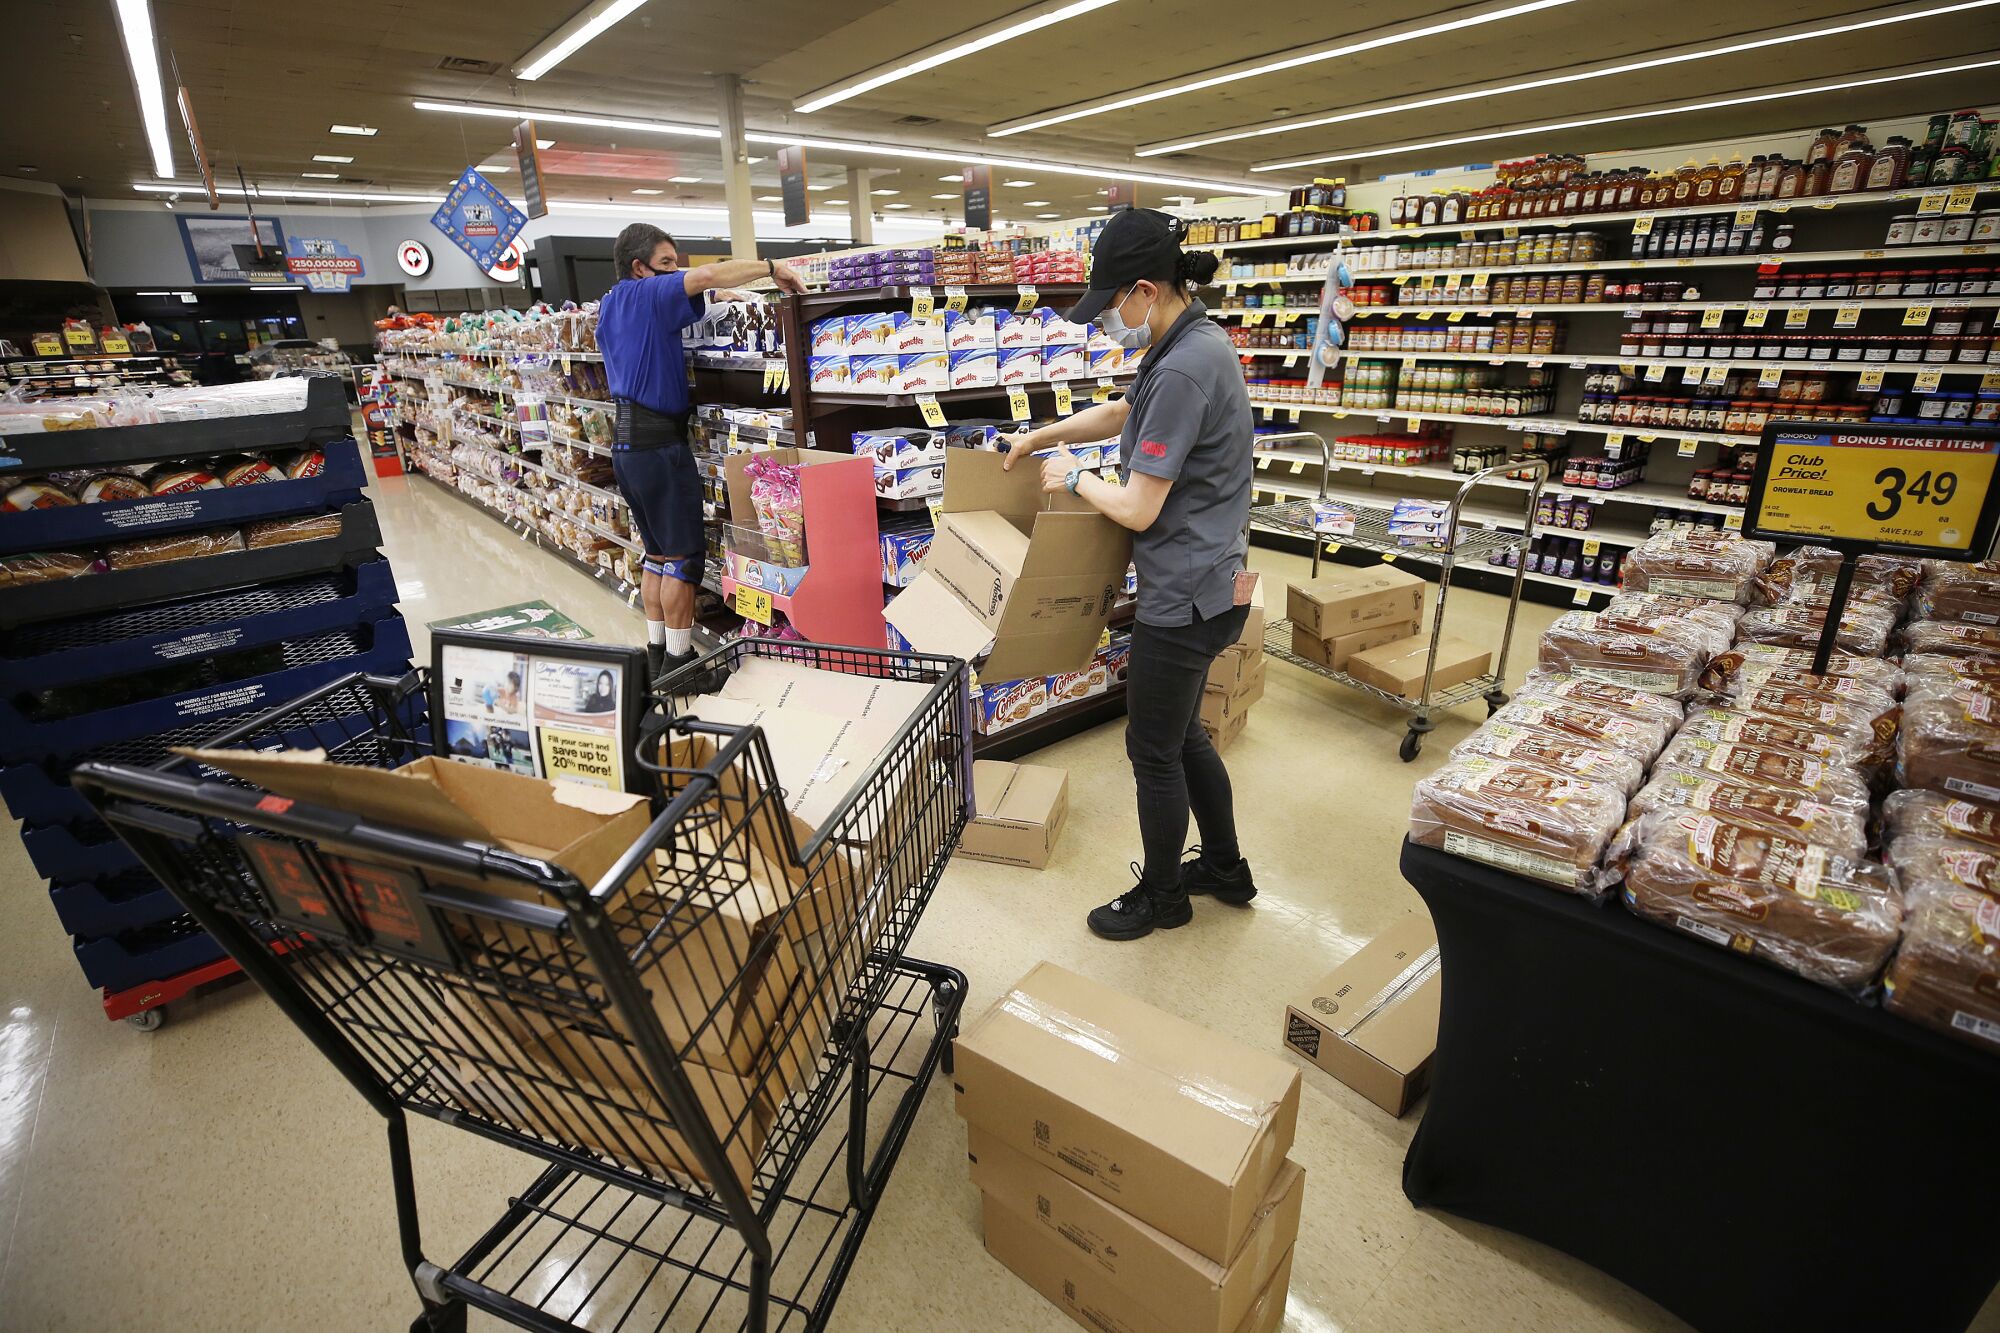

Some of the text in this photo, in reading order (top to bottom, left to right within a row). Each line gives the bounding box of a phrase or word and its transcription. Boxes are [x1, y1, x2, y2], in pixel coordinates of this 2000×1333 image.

[291, 260, 356, 268] $250,000,000
[1705, 312, 1720, 322] 449
[1748, 312, 1764, 321] 449
[1908, 311, 1926, 320] 449
[1838, 436, 1887, 447] BONUS
[1892, 437, 1944, 448] TICKET
[1947, 440, 1985, 450] ITEM
[1787, 454, 1824, 467] Club
[1779, 467, 1828, 480] Price!
[1773, 486, 1834, 497] OROWEAT BREAD
[134, 502, 167, 511] WARNING
[1902, 529, 1923, 537] $1.50
[990, 578, 1002, 615] Hostess
[182, 633, 212, 642] WARNING
[1053, 674, 1079, 696] Coffee
[175, 698, 201, 707] WARNING
[862, 684, 880, 717] Merchandise
[996, 680, 1041, 721] Coffee Cakes
[548, 735, 558, 743] Fill
[827, 720, 852, 756] Merchandise
[552, 746, 607, 762] save up to
[552, 756, 611, 776] 20% more!
